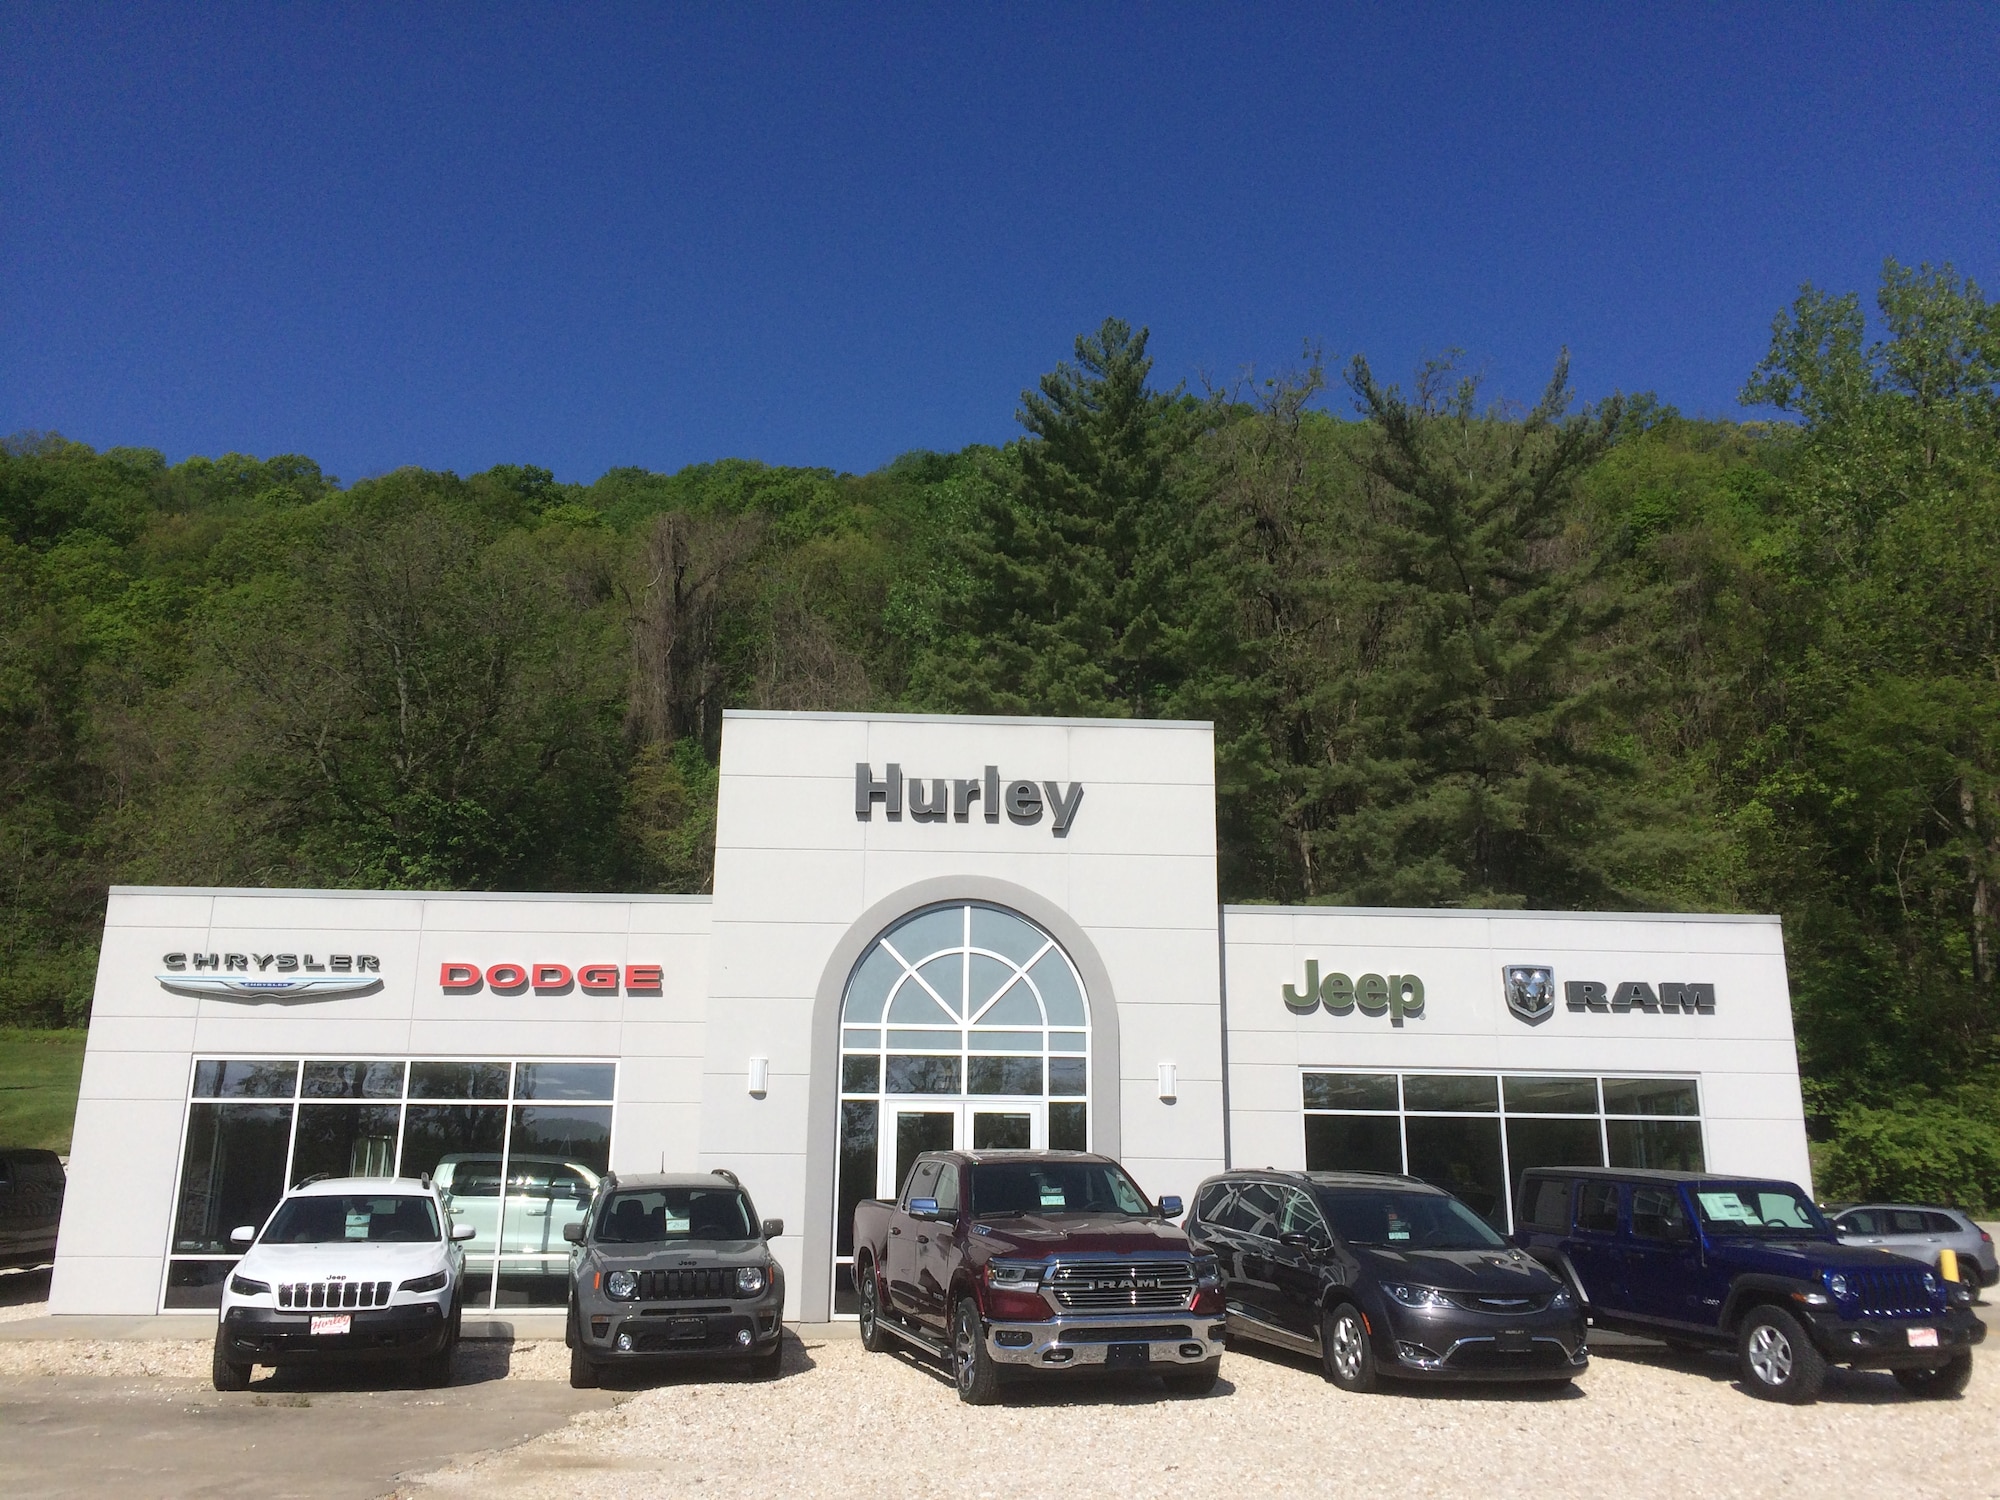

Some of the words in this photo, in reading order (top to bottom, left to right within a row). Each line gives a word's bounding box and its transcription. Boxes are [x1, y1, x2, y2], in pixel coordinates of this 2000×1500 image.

[855, 762, 1083, 832] Hurley
[162, 952, 380, 970] CHRYSLER
[439, 962, 663, 991] DODGE
[1282, 959, 1425, 1021] Jeep
[1564, 980, 1717, 1009] RAM
[1097, 1279, 1155, 1289] RAM
